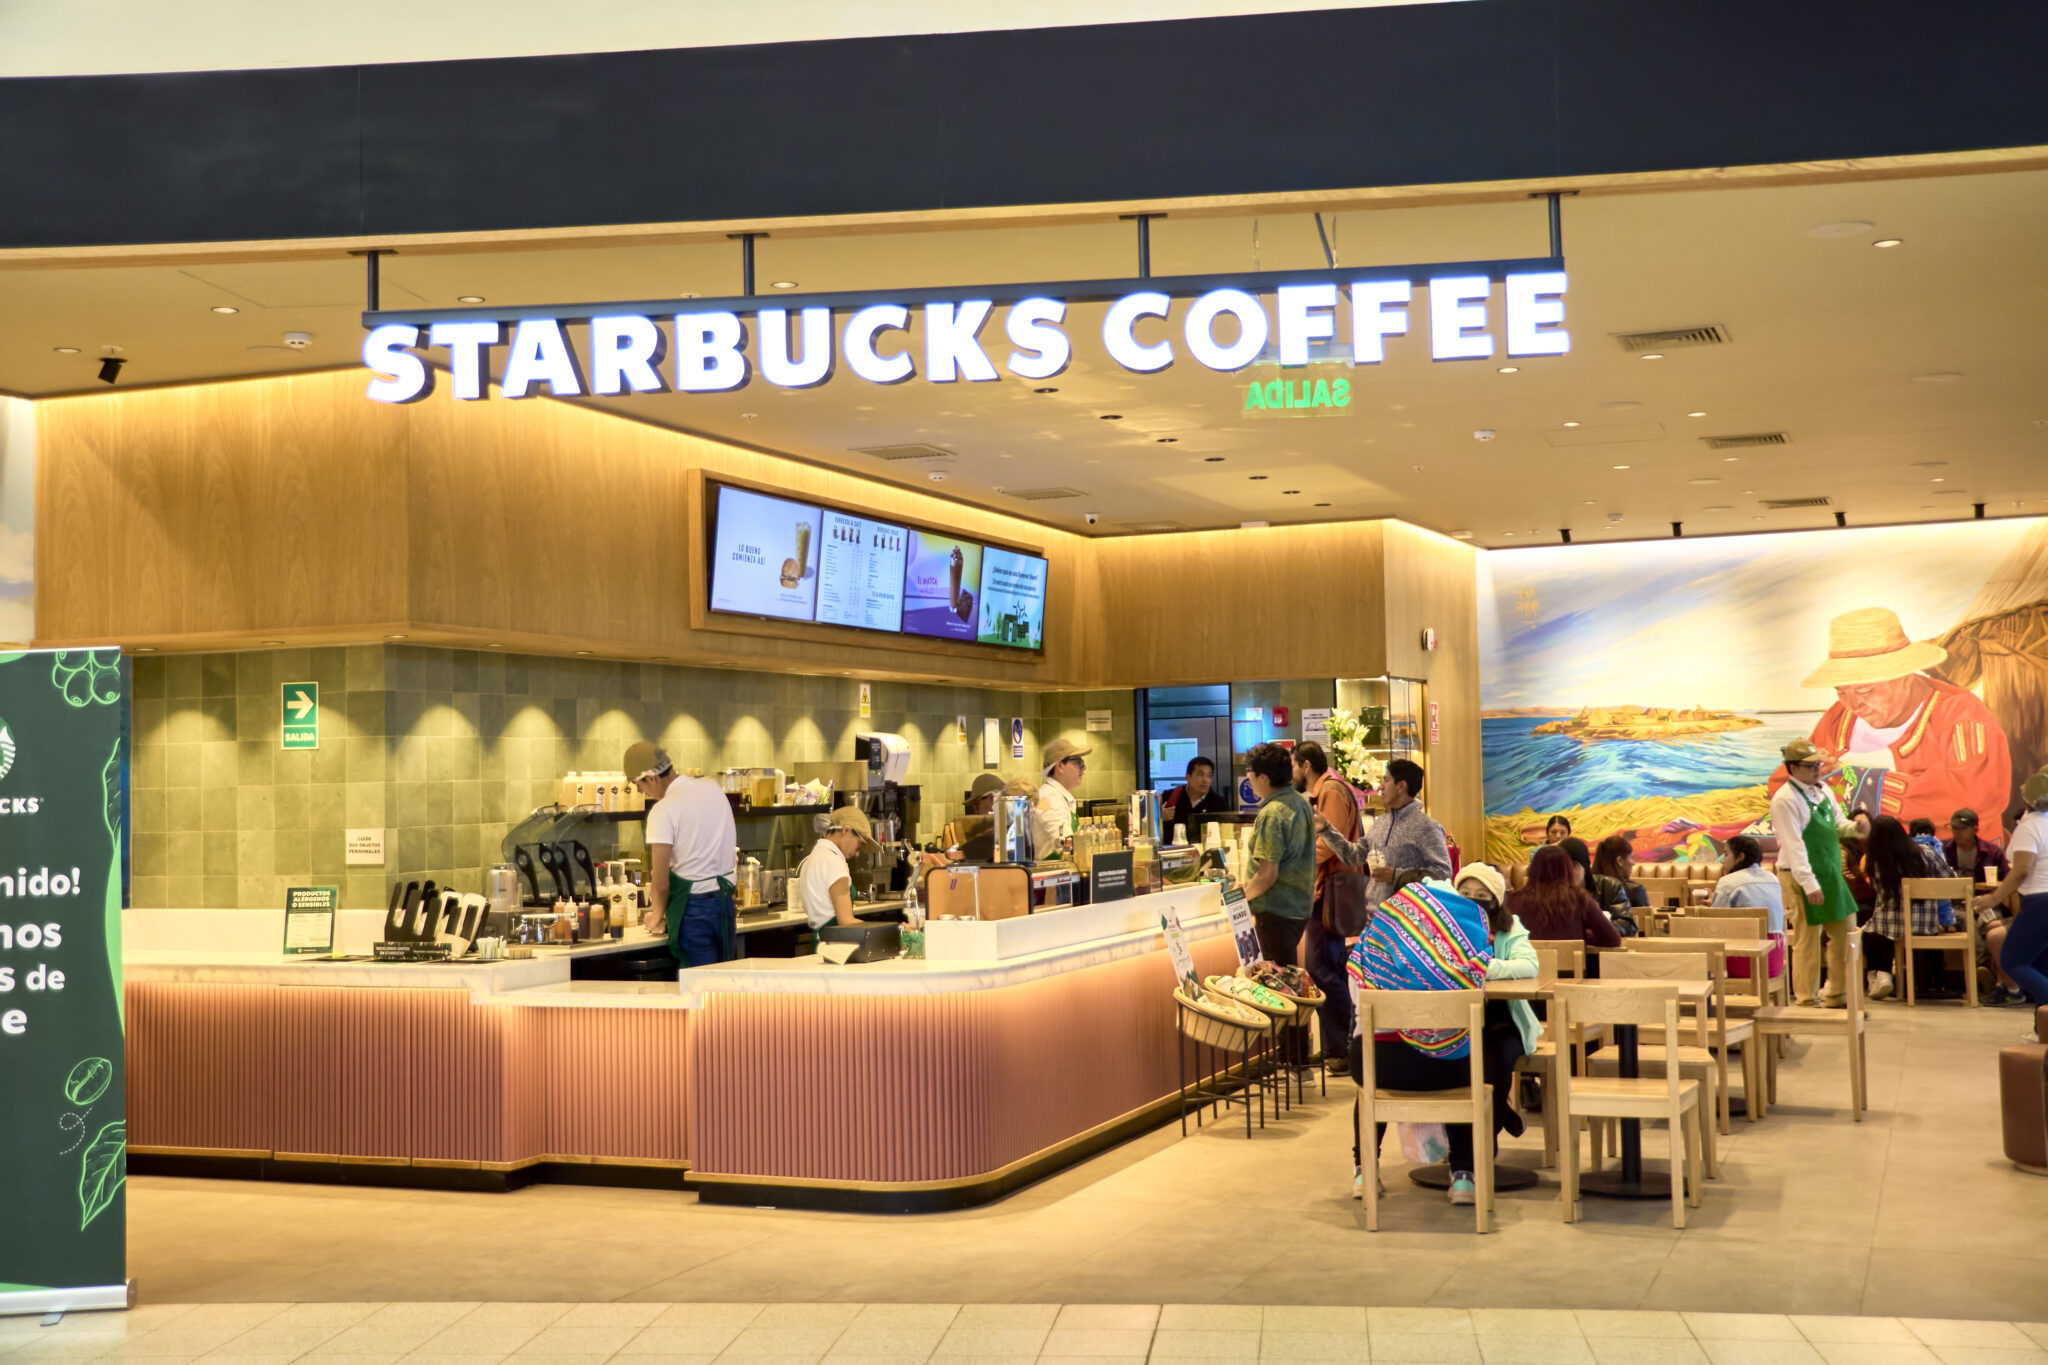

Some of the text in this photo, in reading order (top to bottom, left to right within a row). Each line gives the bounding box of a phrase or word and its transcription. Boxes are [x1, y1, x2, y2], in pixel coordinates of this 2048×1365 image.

[362, 272, 1570, 402] STARBUCKS COFFEE
[285, 732, 315, 742] SALIDA
[26, 963, 66, 991] de
